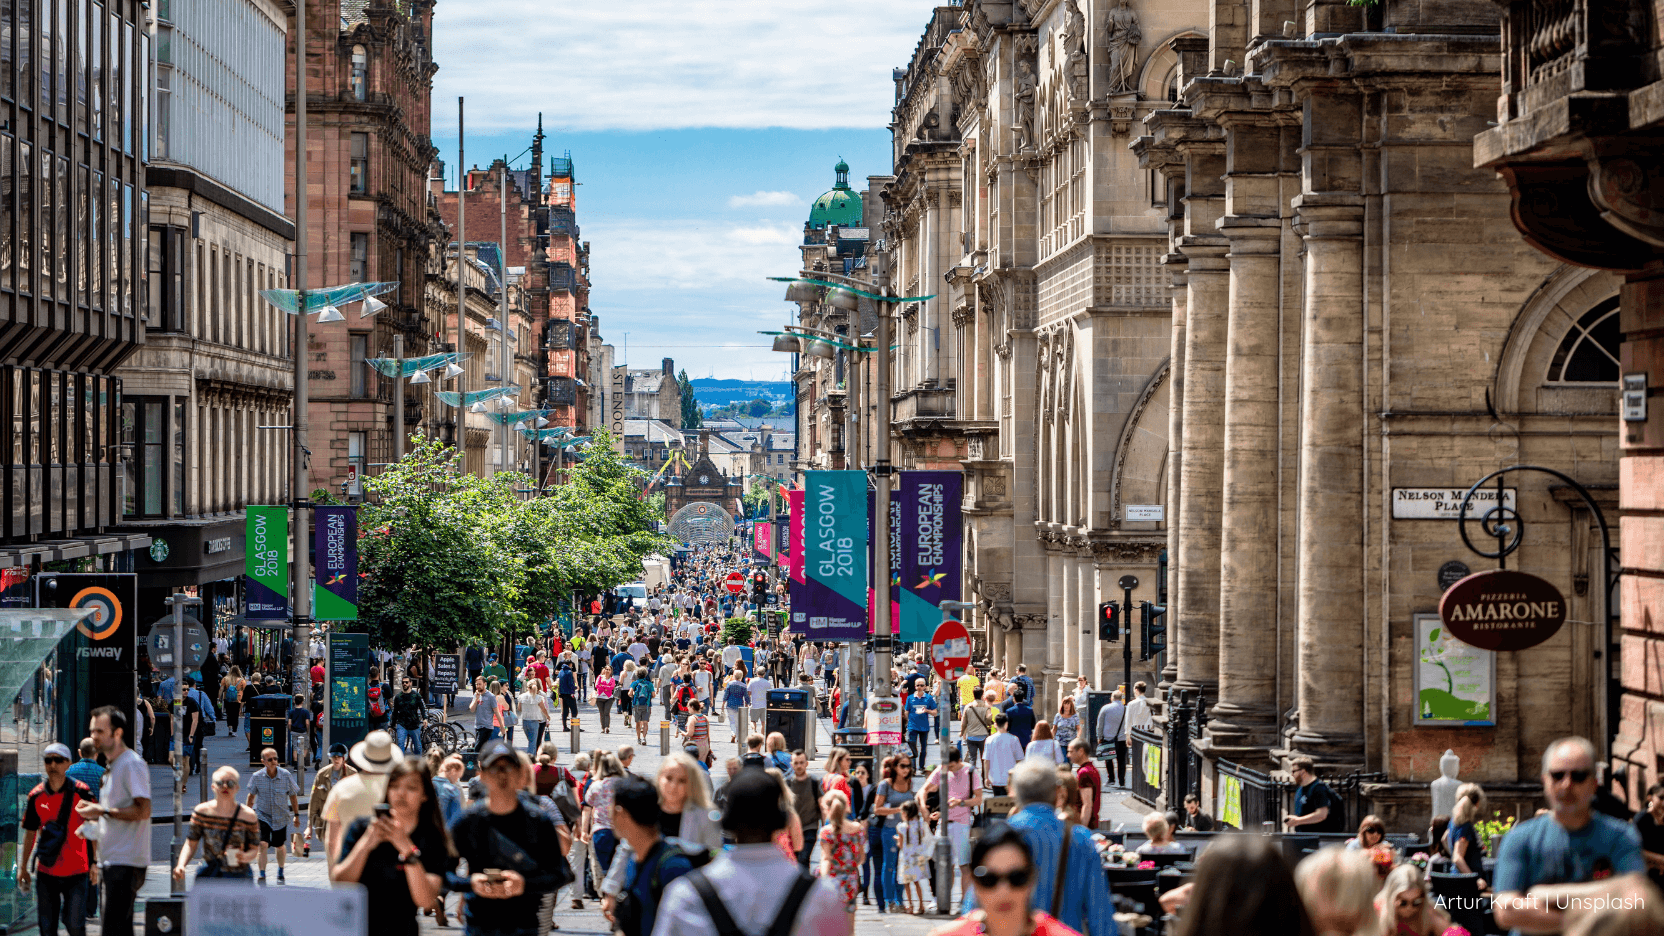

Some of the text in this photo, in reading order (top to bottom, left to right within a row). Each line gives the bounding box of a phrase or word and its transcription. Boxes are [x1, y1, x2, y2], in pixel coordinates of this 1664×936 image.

[613, 374, 622, 388] ST
[1451, 490, 1510, 500] MNDELA
[328, 514, 337, 569] EUROPEAN
[819, 484, 835, 576] GLASGOW
[918, 484, 932, 566] EUROPEAN
[933, 484, 943, 566] CHAMPIONSHIPS
[255, 515, 266, 576] GLASGOW
[267, 550, 278, 576] 2018
[837, 538, 853, 576] 2018
[1450, 602, 1560, 622] AMARONE
[1472, 621, 1536, 630] RISTORANTE
